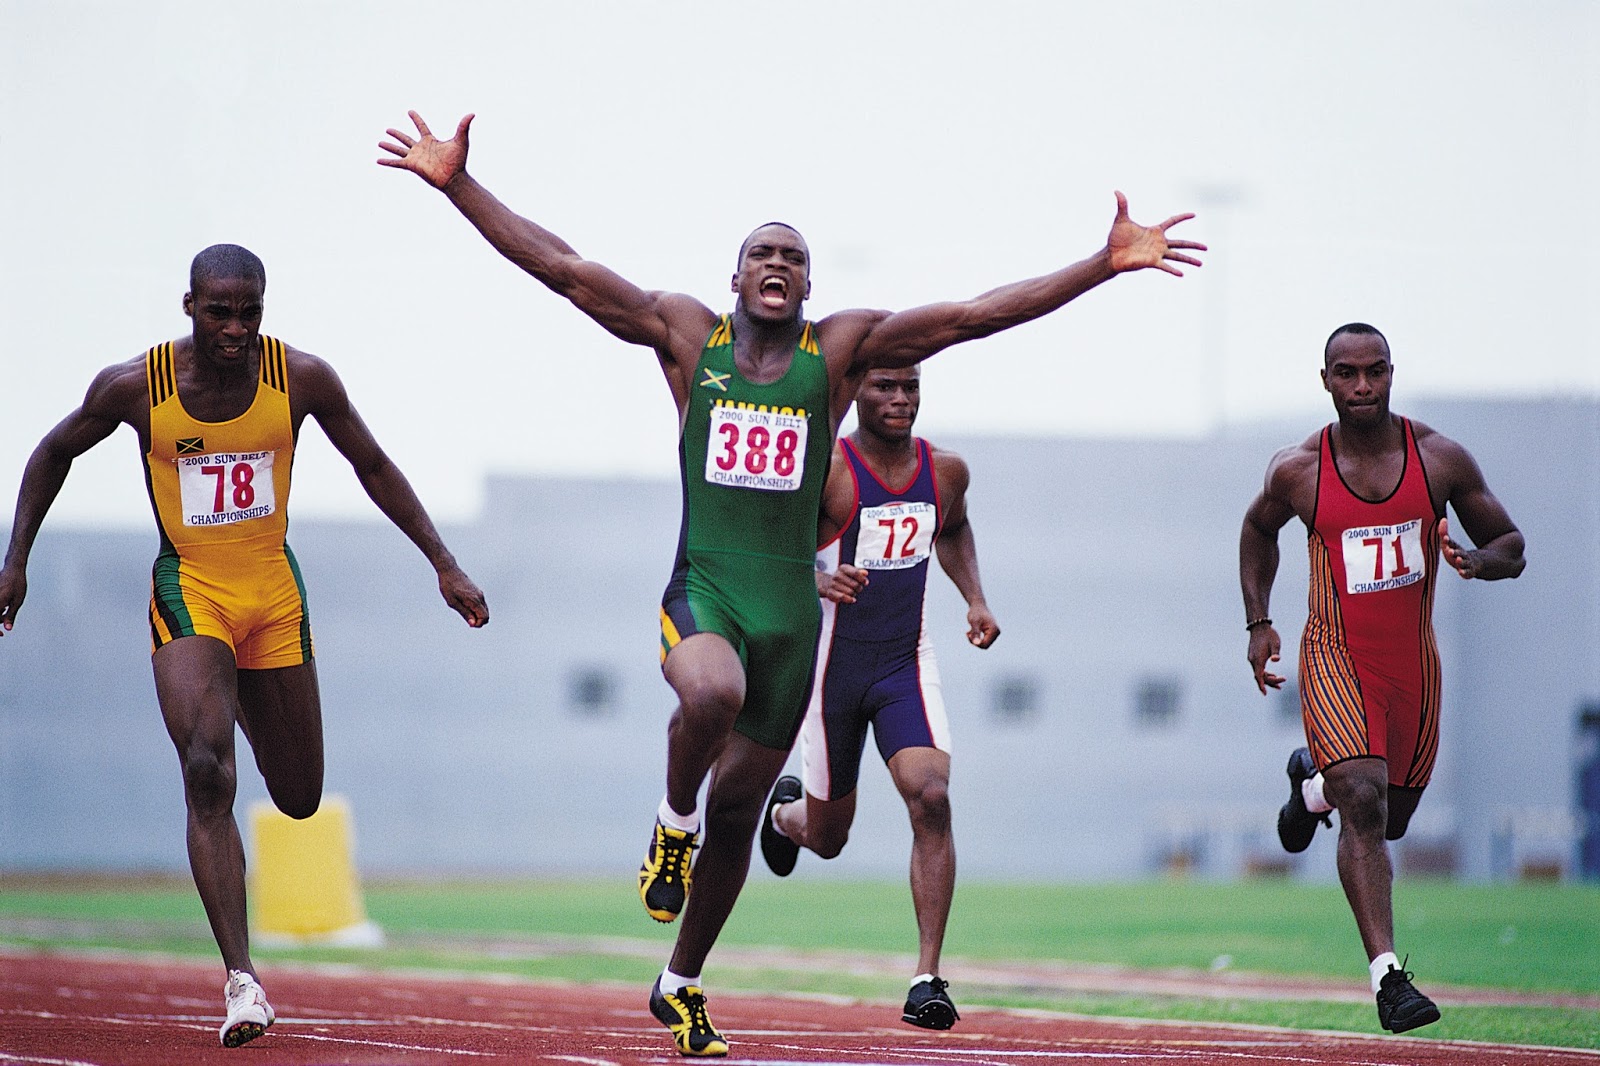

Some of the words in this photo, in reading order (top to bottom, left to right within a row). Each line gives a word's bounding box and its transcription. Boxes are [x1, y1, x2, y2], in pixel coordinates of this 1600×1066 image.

[719, 410, 743, 421] 2000
[748, 414, 770, 425] SUN
[775, 416, 802, 429] BELT
[185, 456, 210, 466] 2000
[214, 454, 237, 465] SUN
[241, 451, 269, 461] BELT
[716, 422, 798, 477] 388
[201, 462, 255, 513] 78
[908, 504, 929, 514] BELT
[878, 516, 918, 559] 72
[1348, 529, 1370, 539] 2000
[1373, 526, 1392, 536] SUN
[1396, 521, 1417, 534] BELT
[1362, 535, 1410, 580] 71
